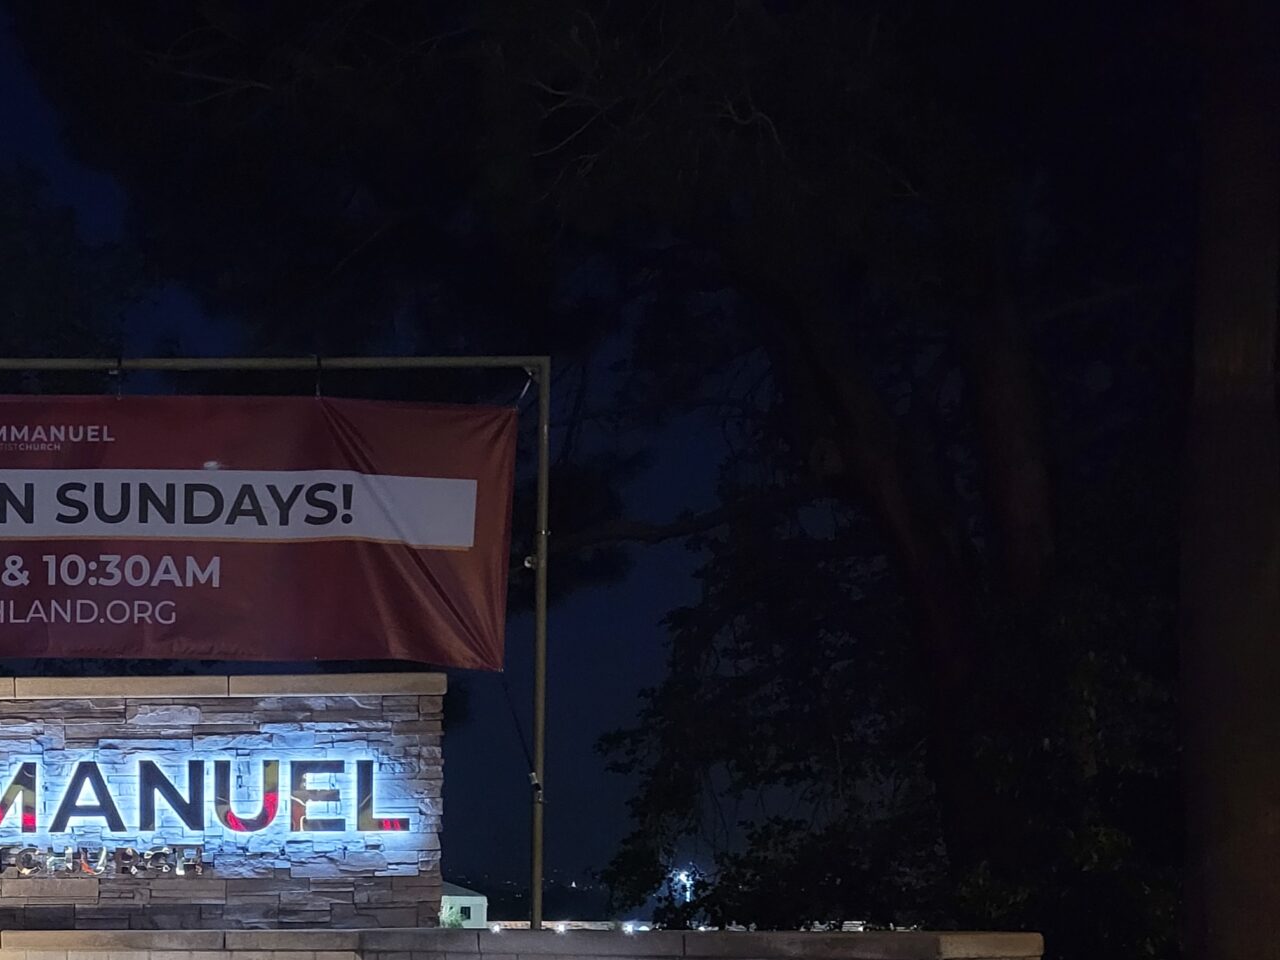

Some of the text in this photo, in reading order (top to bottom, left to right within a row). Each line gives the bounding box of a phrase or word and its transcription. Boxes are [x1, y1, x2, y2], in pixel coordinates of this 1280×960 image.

[55, 482, 354, 526] SUNDAYS!
[1, 555, 30, 587] &
[42, 554, 220, 588] 10:30AM
